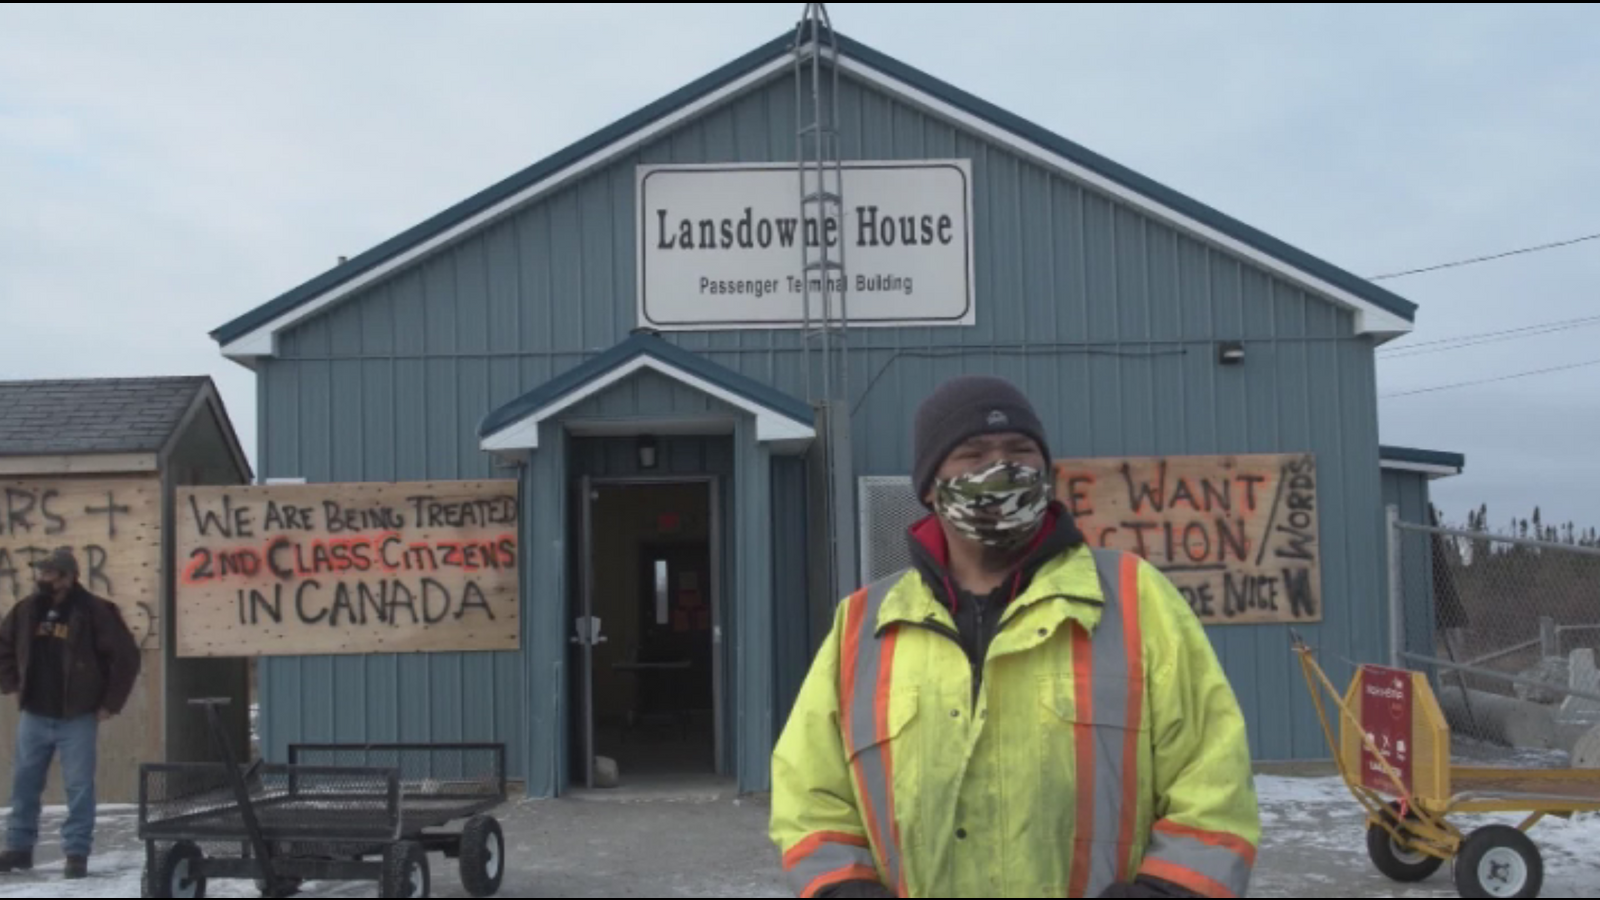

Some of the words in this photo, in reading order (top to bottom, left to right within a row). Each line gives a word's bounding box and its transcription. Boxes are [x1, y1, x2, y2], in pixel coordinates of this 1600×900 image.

[656, 206, 838, 250] Lansdowne
[856, 205, 953, 248] House
[700, 276, 778, 298] Passenger
[856, 274, 913, 296] Building
[1119, 460, 1265, 514] WANT
[1275, 454, 1316, 562] WORDS
[189, 494, 254, 538] WE
[263, 499, 316, 532] ARE
[323, 498, 406, 533] BEING
[406, 494, 518, 529] TREATED
[184, 546, 262, 585] 2ND
[264, 533, 372, 580] CLASS
[379, 531, 516, 572] CITIZENS
[1095, 518, 1248, 563] CTION
[238, 582, 283, 626] IN
[294, 576, 496, 627] CANADA
[1222, 571, 1279, 619] NICE
